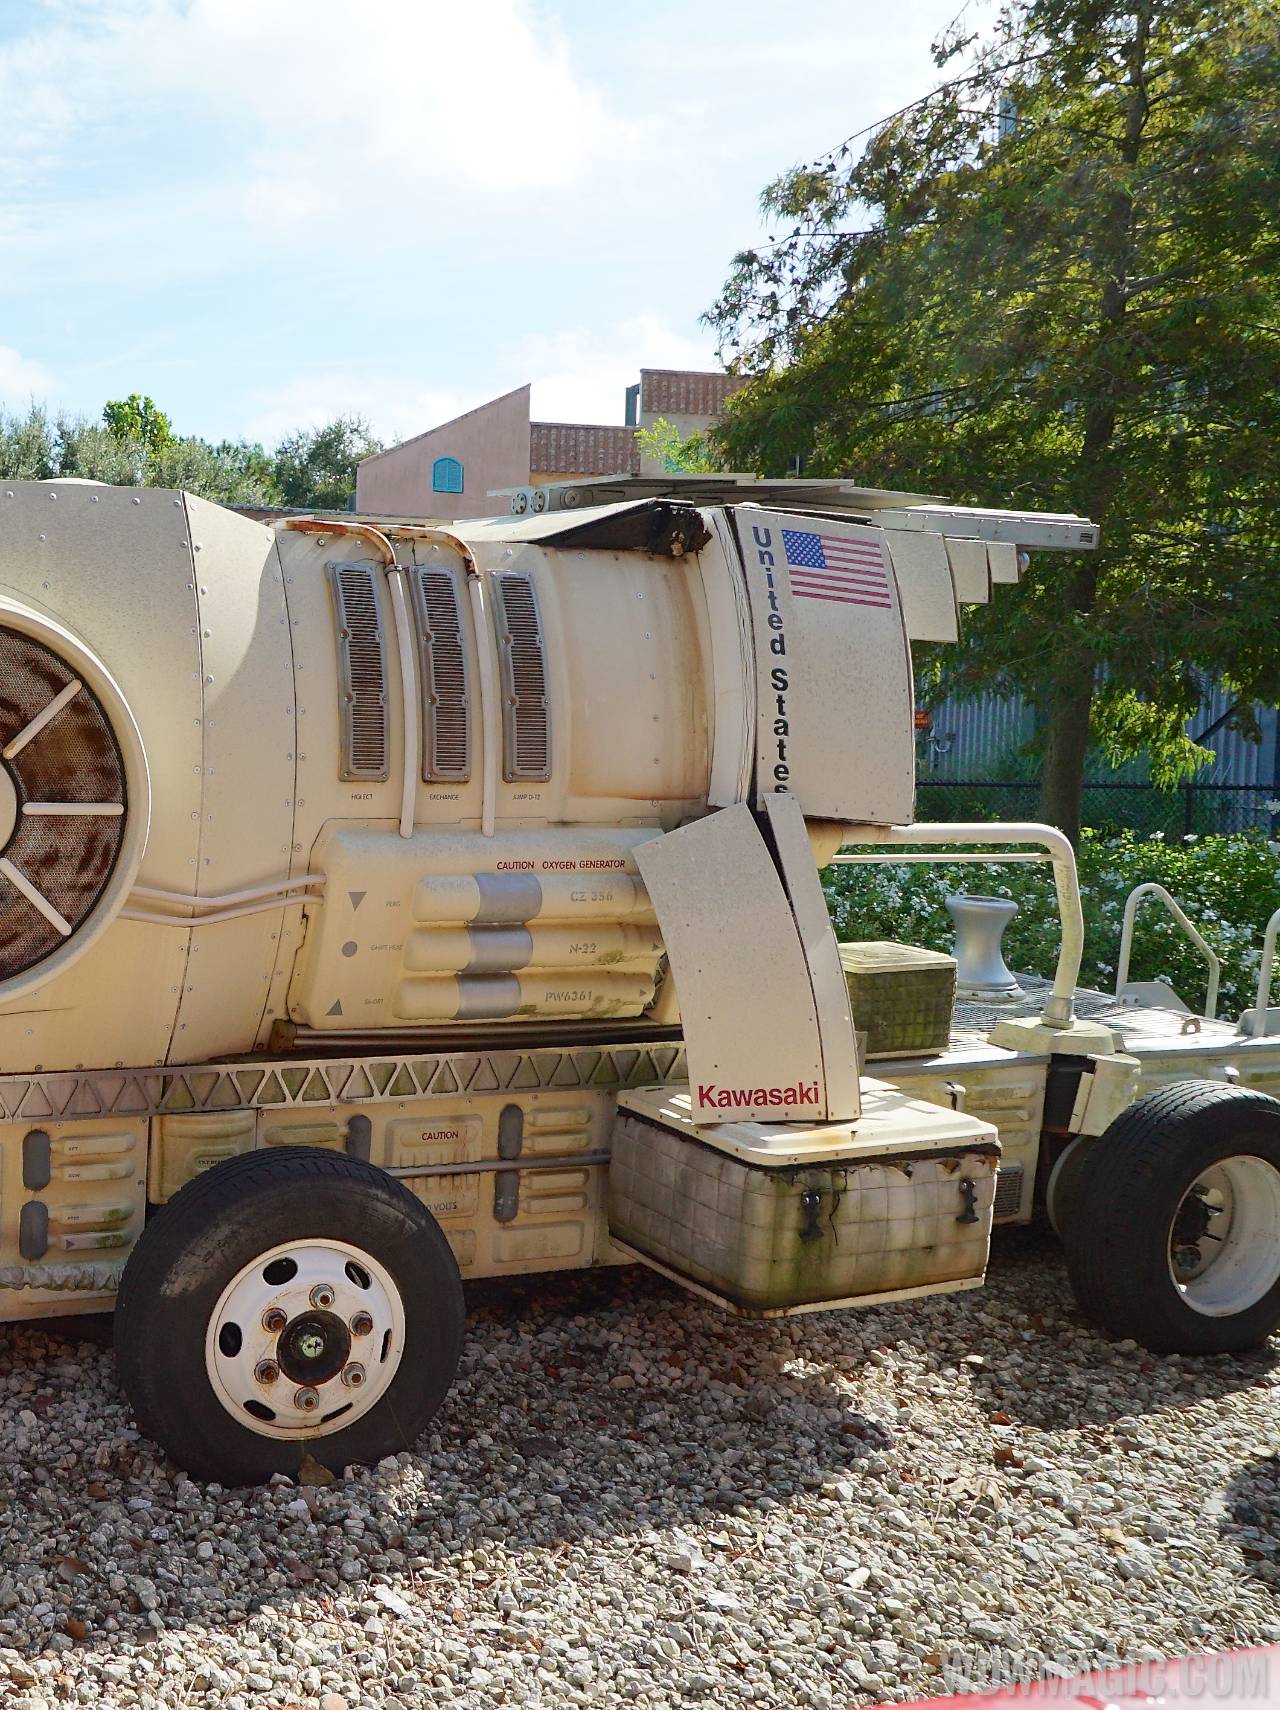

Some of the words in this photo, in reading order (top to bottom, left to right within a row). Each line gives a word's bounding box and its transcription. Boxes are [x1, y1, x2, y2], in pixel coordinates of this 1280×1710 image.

[752, 526, 786, 656] United
[496, 861, 535, 870] CAUTION
[542, 861, 576, 870] OXYGEN
[579, 860, 626, 869] GENERATOR
[569, 943, 597, 954] N-22
[545, 991, 593, 1002] PW6361
[697, 1081, 820, 1108] Kawasaki
[421, 1130, 459, 1141] CAUTION
[433, 1201, 458, 1211] VOLTS
